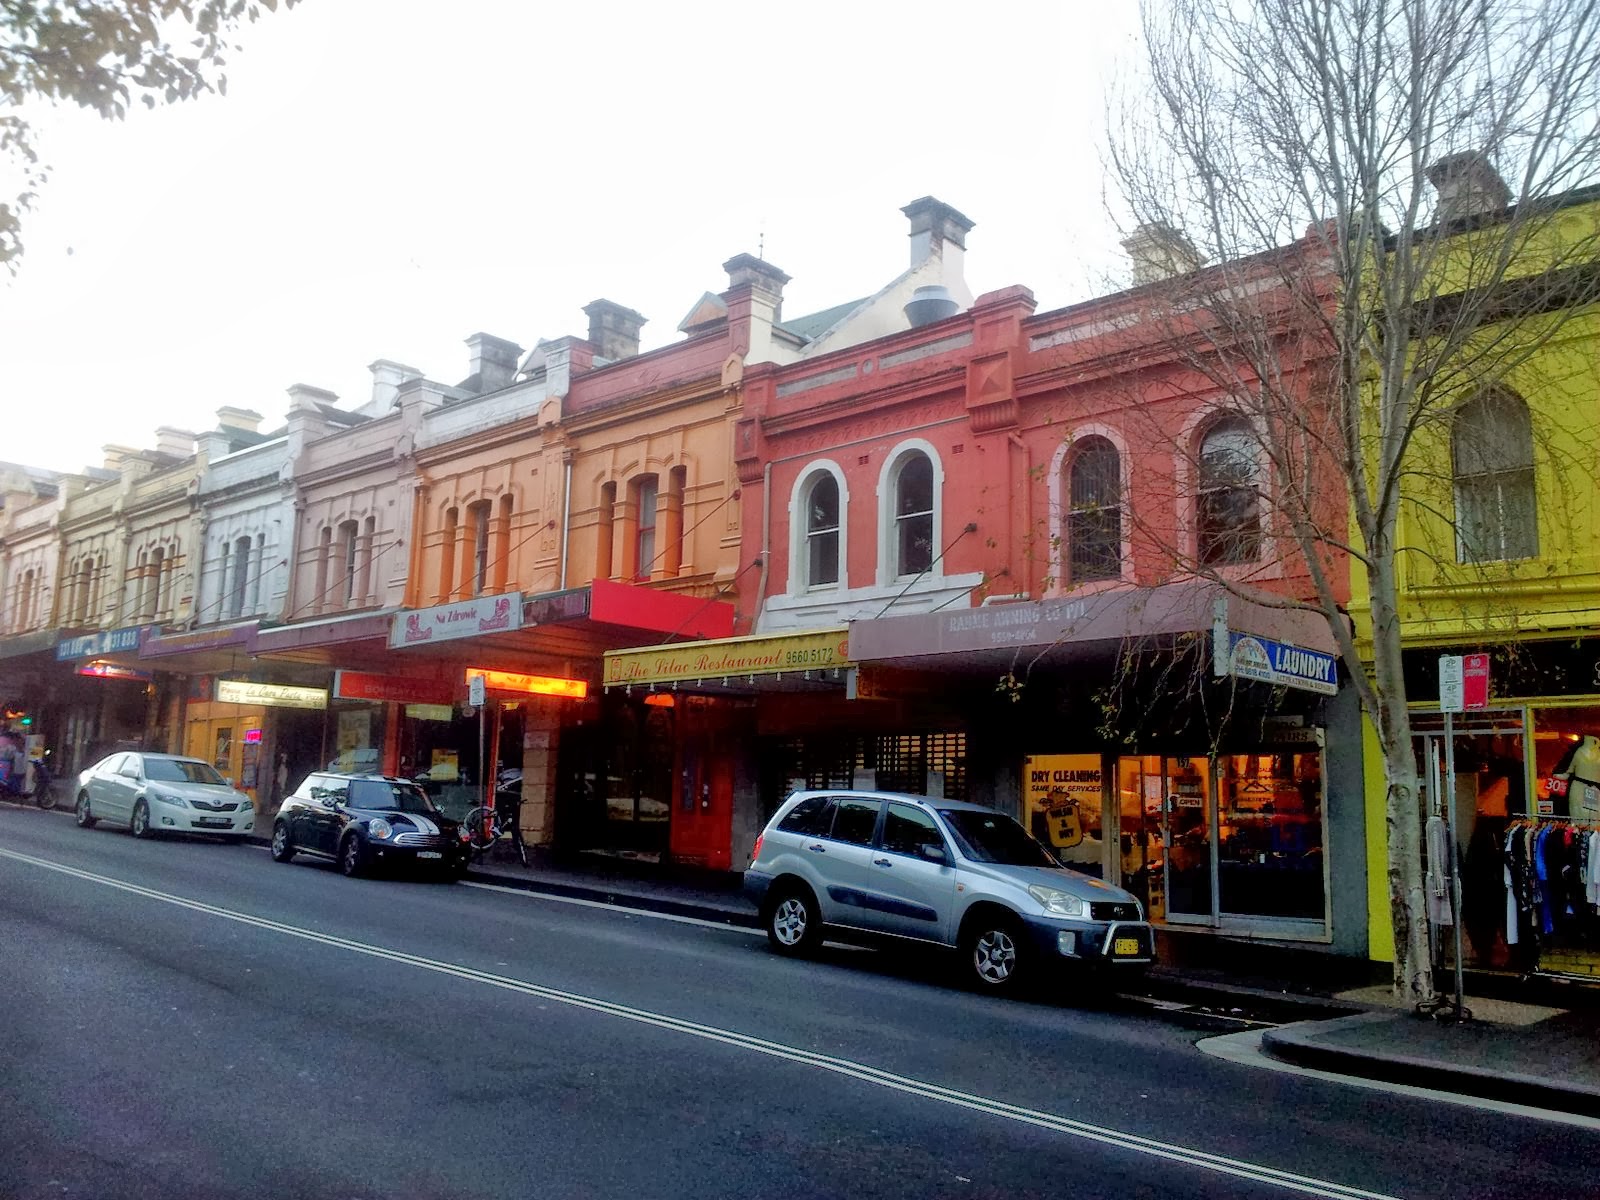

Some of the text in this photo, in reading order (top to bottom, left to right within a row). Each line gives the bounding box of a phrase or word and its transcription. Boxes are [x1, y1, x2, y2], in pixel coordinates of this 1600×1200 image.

[993, 607, 1041, 627] AWNING
[624, 661, 649, 678] The
[654, 657, 689, 675] Lilac
[693, 648, 782, 672] Restaurant
[786, 650, 809, 664] 9660
[1275, 646, 1332, 681] LAUNDRY
[1031, 769, 1102, 783] DRY CLEANING
[1179, 798, 1201, 807] OPEN
